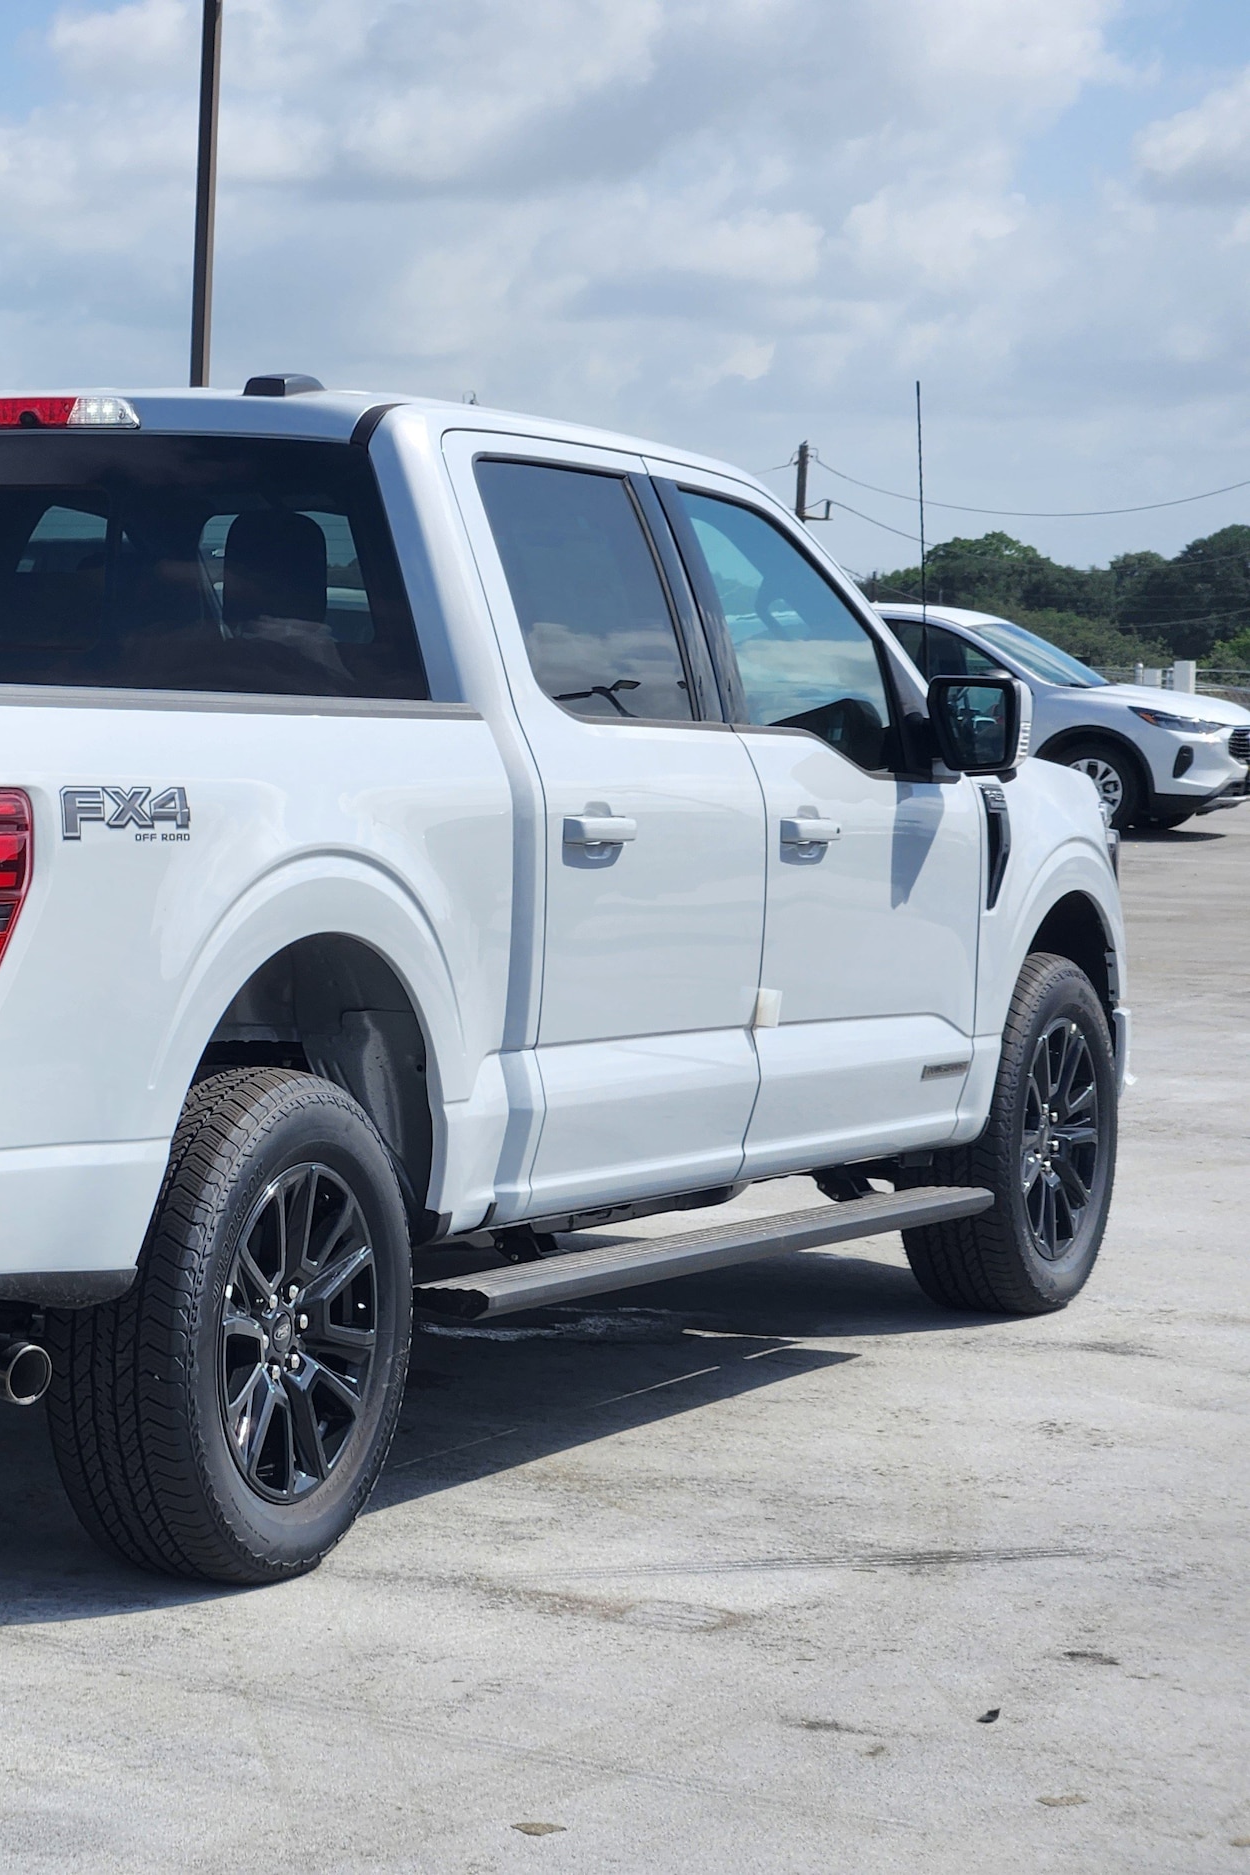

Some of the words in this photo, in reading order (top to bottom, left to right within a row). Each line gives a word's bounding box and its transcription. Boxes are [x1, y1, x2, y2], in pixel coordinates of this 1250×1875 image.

[58, 785, 191, 841] FX4
[135, 833, 157, 842] OFF
[161, 833, 191, 842] ROAD
